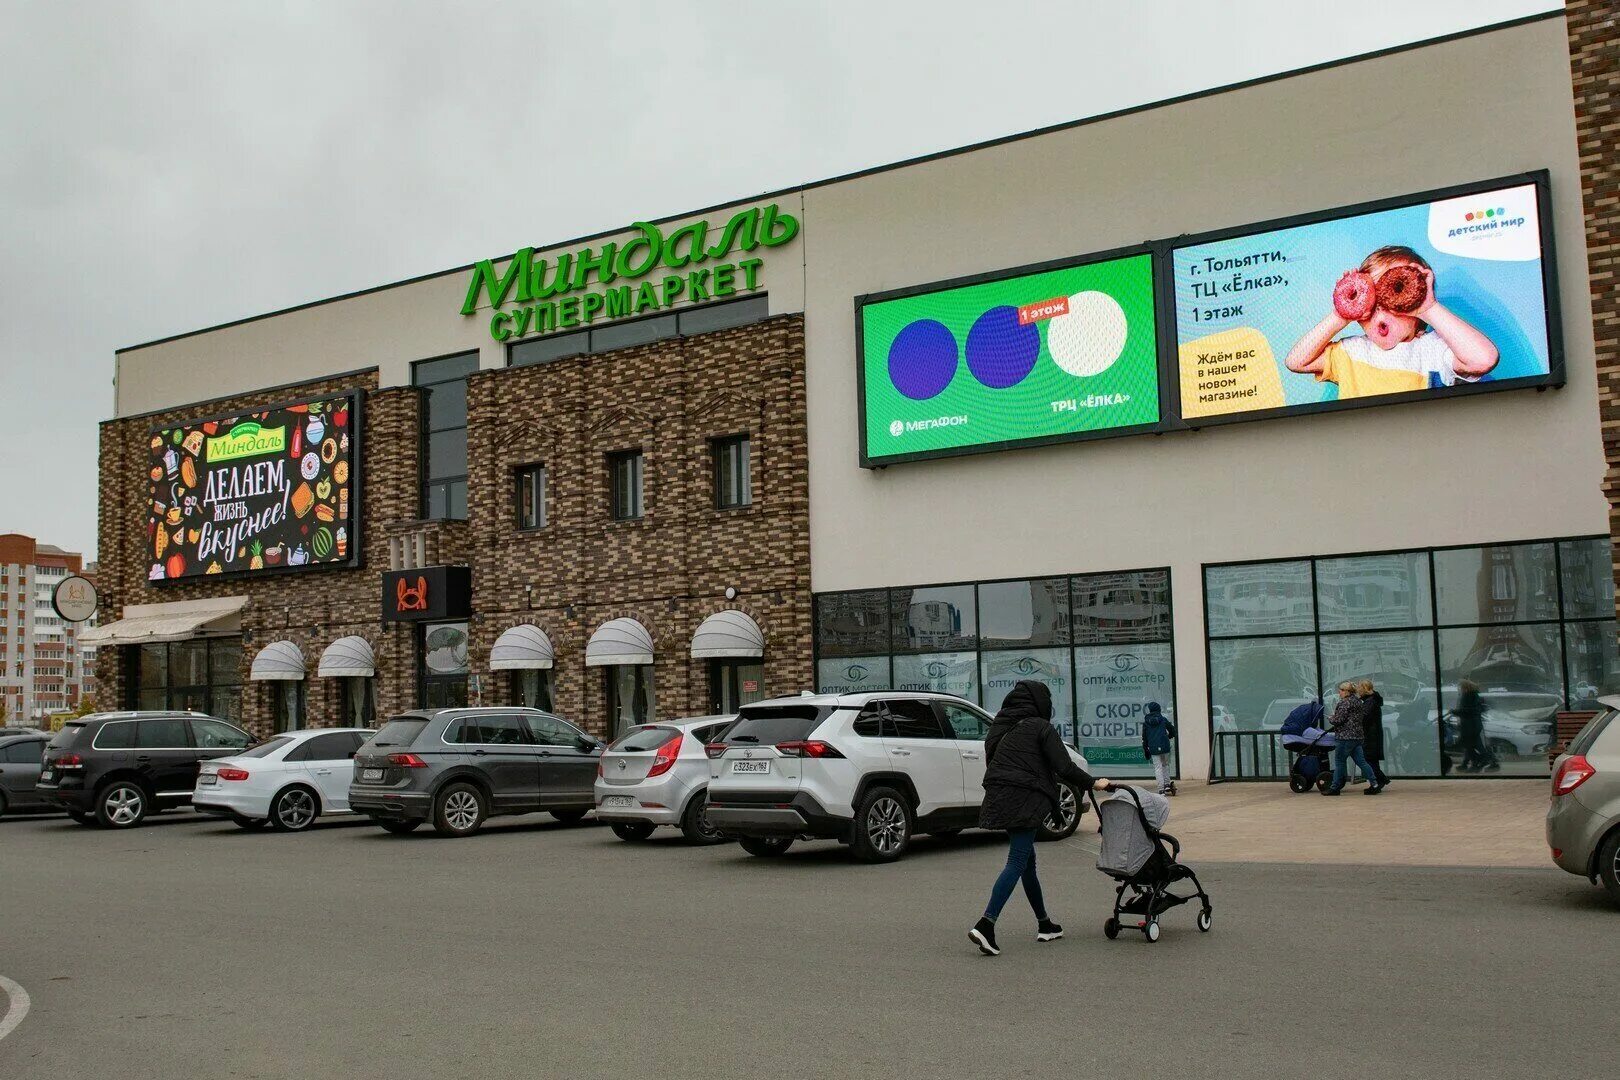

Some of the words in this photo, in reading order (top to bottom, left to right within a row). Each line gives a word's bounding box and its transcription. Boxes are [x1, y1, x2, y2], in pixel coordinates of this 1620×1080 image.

[1448, 220, 1498, 237] детский
[1501, 217, 1525, 227] мир
[460, 204, 799, 315] Миндаль
[1190, 262, 1201, 276] г.
[1203, 248, 1287, 273] Тольятти,
[1190, 281, 1218, 300] ТЦ
[1221, 271, 1289, 293] «Ёлка»,
[490, 258, 763, 341] СУПЕРМАРКЕТ
[1021, 310, 1028, 320] 1
[1192, 309, 1200, 322] 1
[1203, 303, 1244, 322] этаж
[1197, 351, 1233, 366] Ждём
[1235, 349, 1256, 360] вас
[1197, 368, 1204, 378] в
[1207, 362, 1247, 377] нашем
[1198, 378, 1237, 391] новом
[1051, 399, 1076, 412] ТРЦ
[1079, 392, 1131, 408] «ЁЛКА»
[1199, 386, 1258, 404] магазине!
[905, 414, 968, 432] МЕГАФОН
[211, 436, 282, 456] Миндаль
[203, 459, 285, 508] ДЕЛАЕМ
[198, 479, 291, 562] вкуснее!
[821, 683, 850, 694] оптик
[900, 682, 930, 691] оптик
[988, 680, 1021, 689] опти
[1083, 676, 1118, 685] оптик
[1120, 674, 1165, 690] мастер
[1081, 722, 1144, 737] ОТКРЫ
